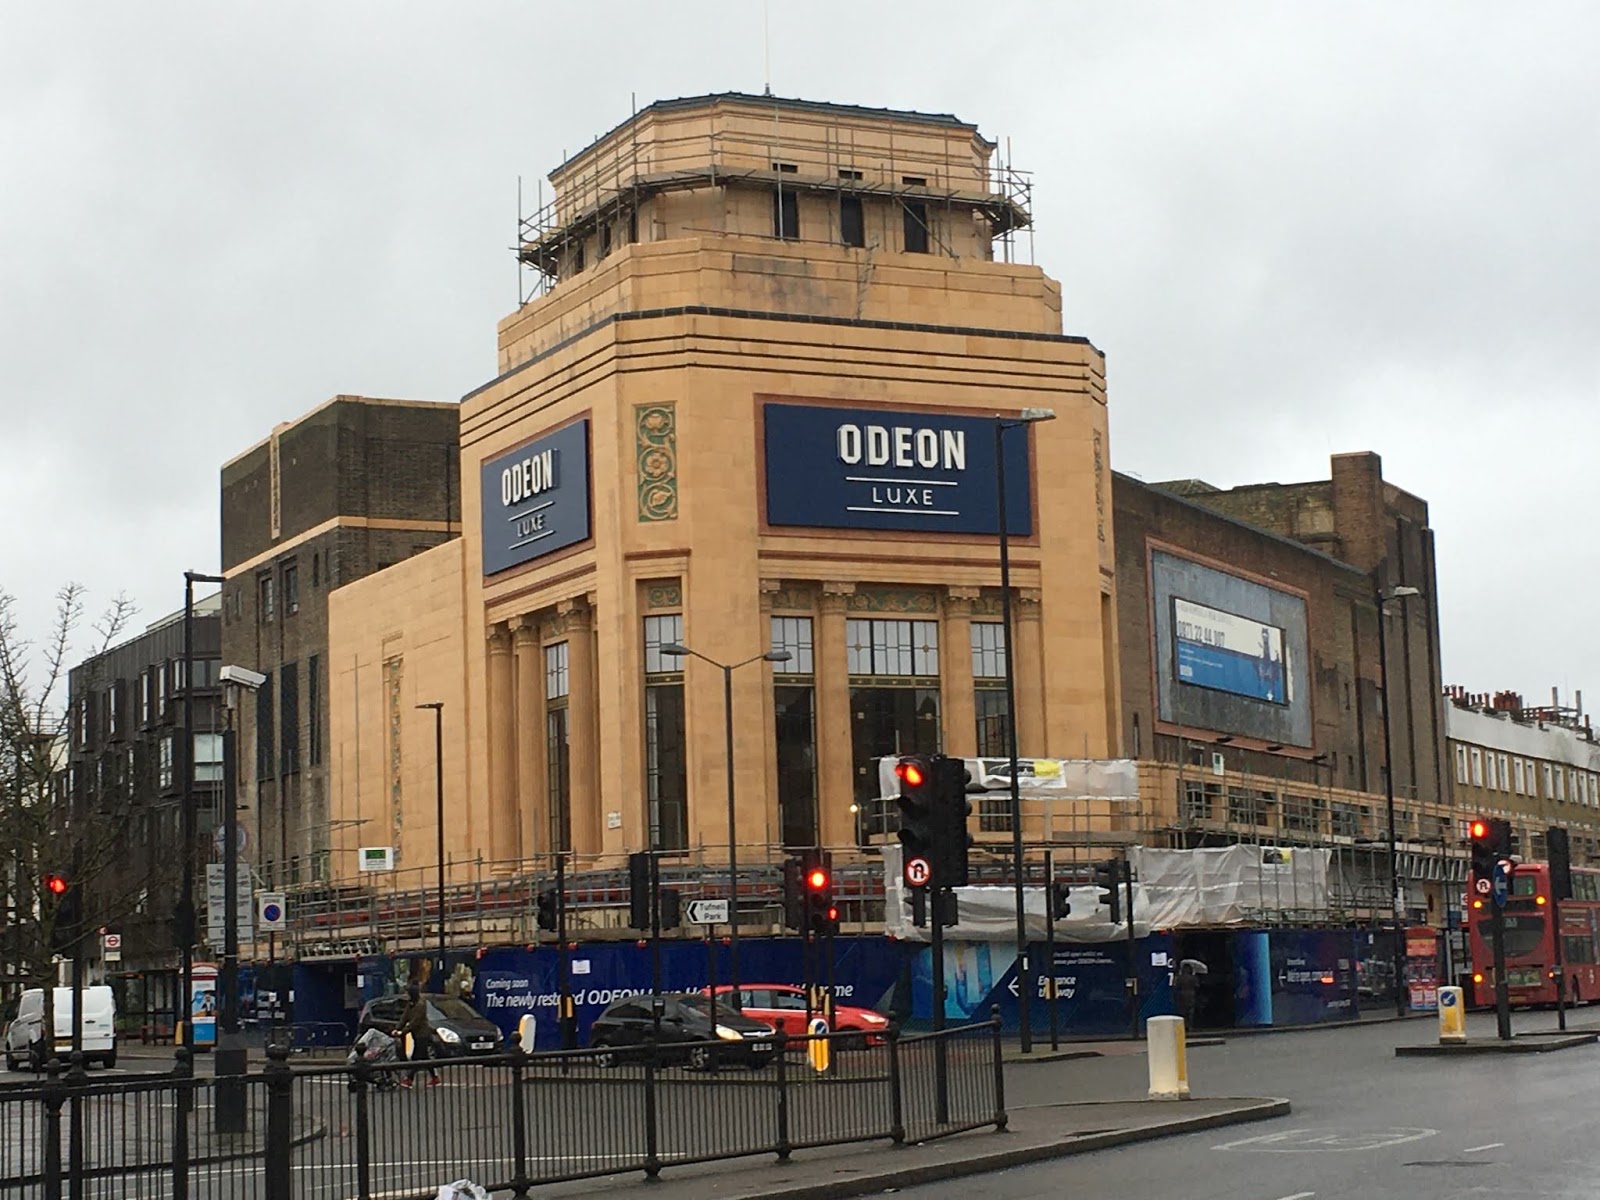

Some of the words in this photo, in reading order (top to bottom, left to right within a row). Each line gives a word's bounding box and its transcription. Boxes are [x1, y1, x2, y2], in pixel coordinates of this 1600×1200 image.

[837, 424, 965, 470] ODEON
[502, 449, 554, 507] ODEON
[872, 486, 933, 506] LUXE
[516, 513, 546, 538] LUXE
[485, 978, 511, 991] Coming
[511, 979, 529, 989] soon
[485, 991, 505, 1008] The
[505, 990, 537, 1010] newly
[537, 988, 586, 1006] restd
